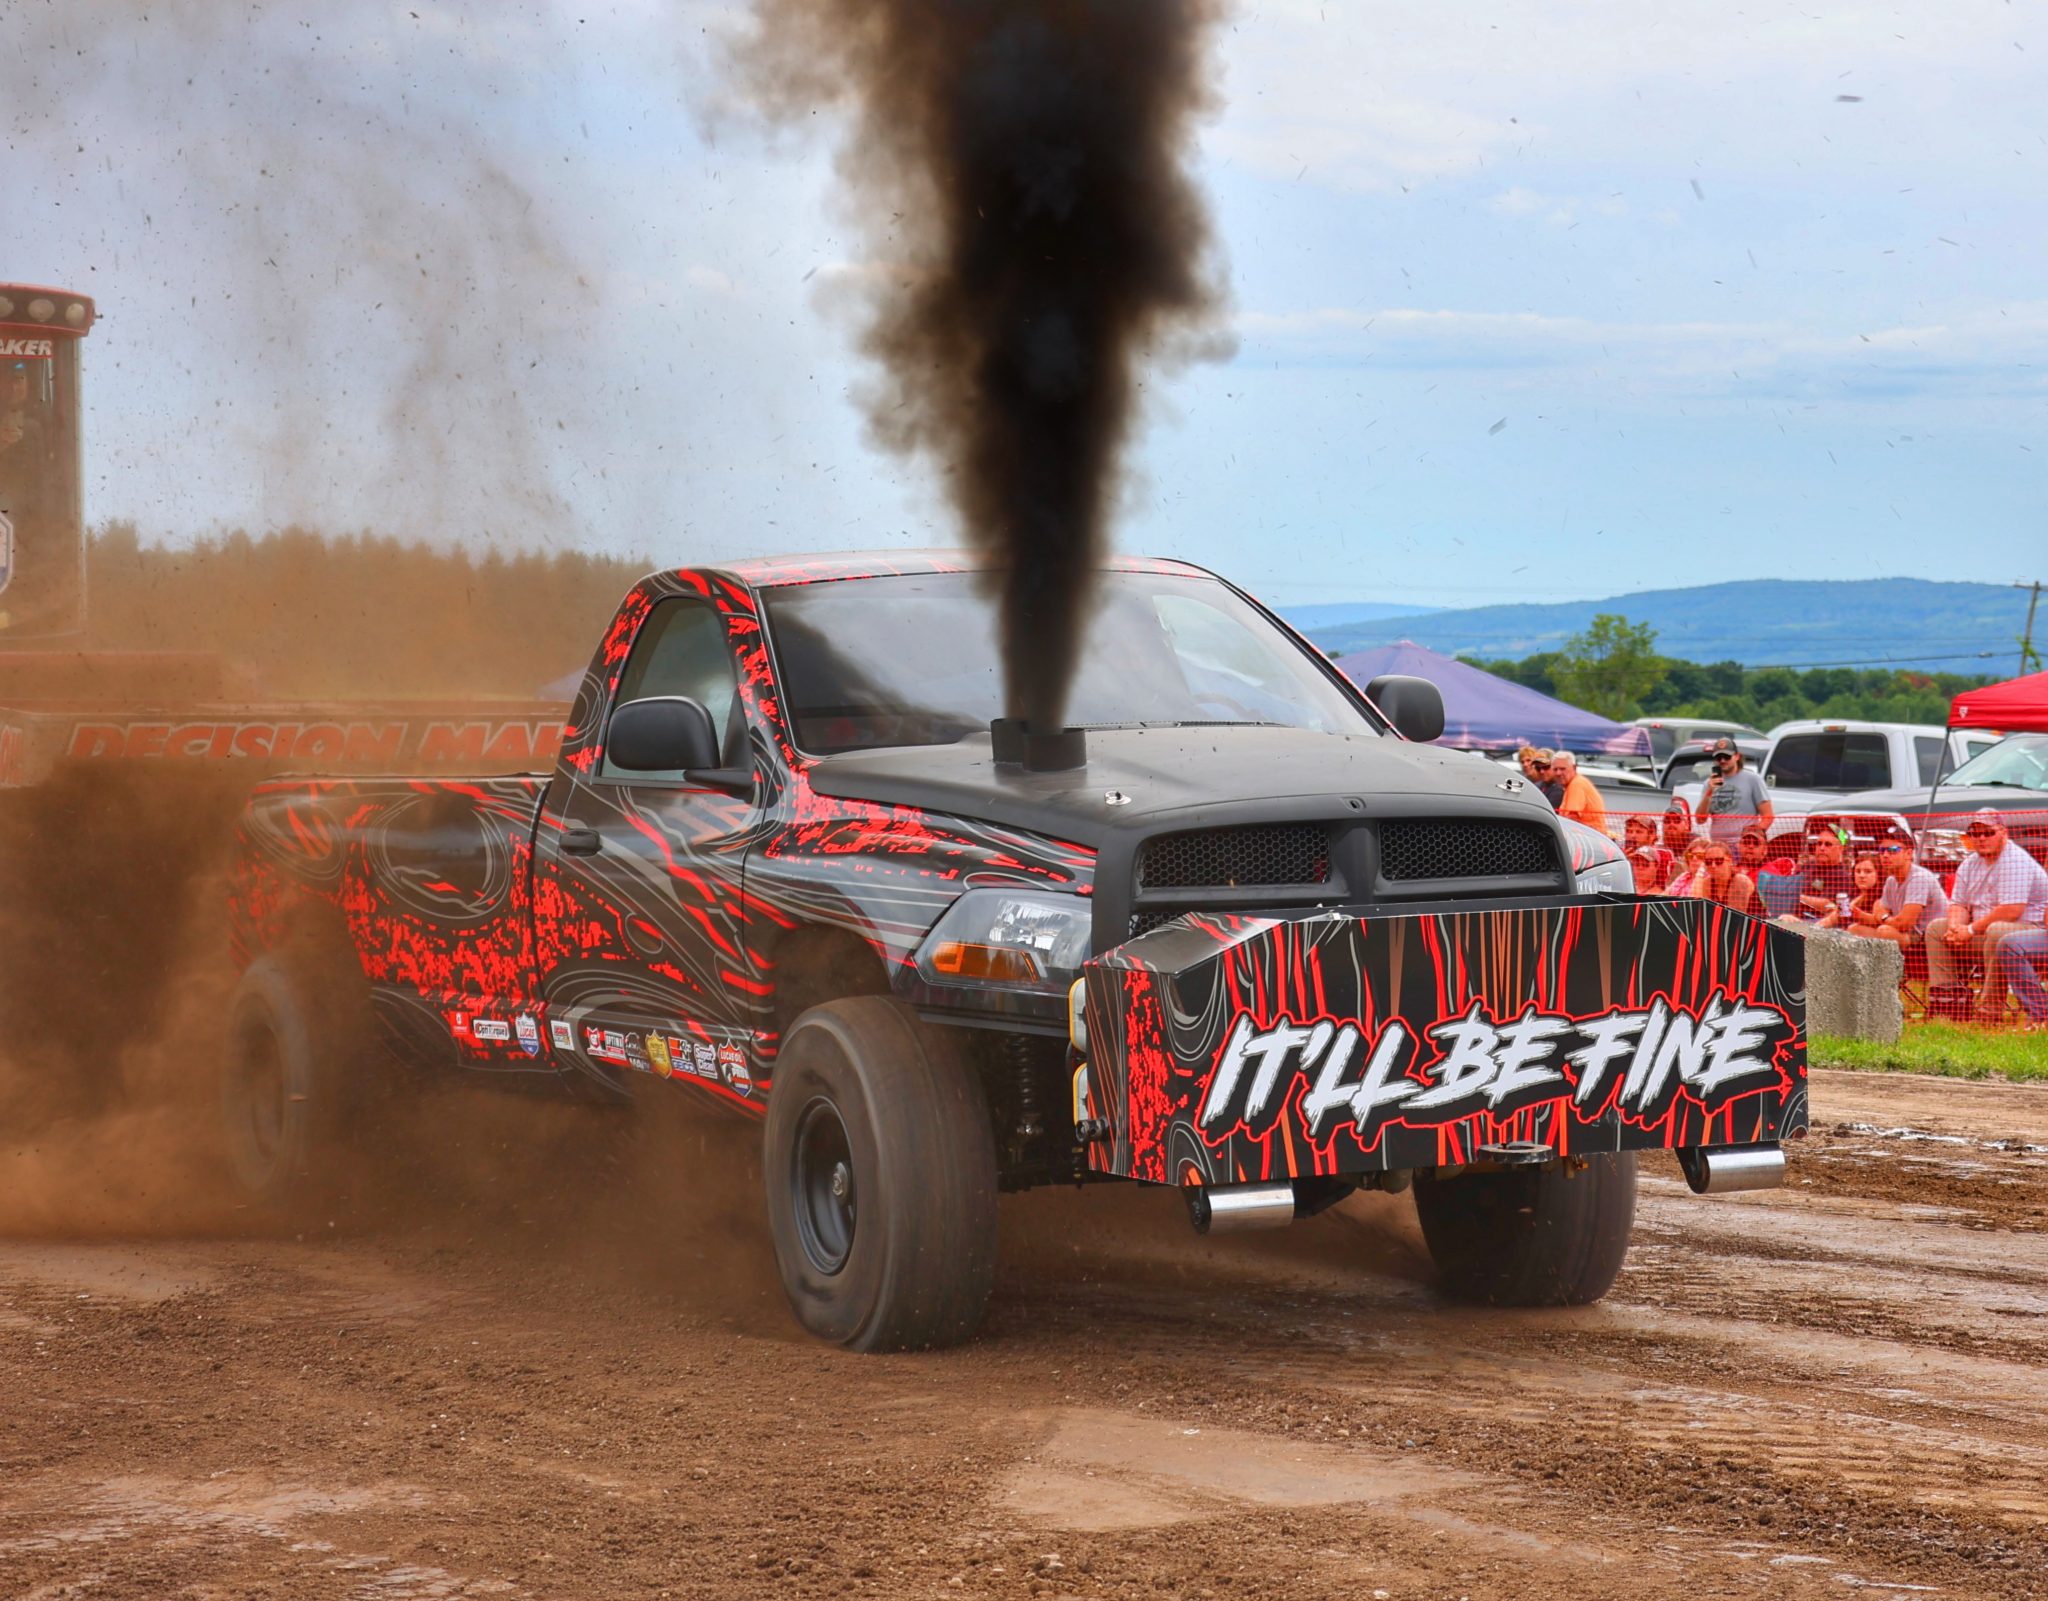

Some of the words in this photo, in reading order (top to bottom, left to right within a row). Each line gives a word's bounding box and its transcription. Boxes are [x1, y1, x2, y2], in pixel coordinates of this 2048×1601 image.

[66, 721, 408, 759] DECISION
[1202, 1014, 1423, 1135] IT'LL
[1400, 1003, 1571, 1109] BE
[1569, 991, 1782, 1111] FINE
